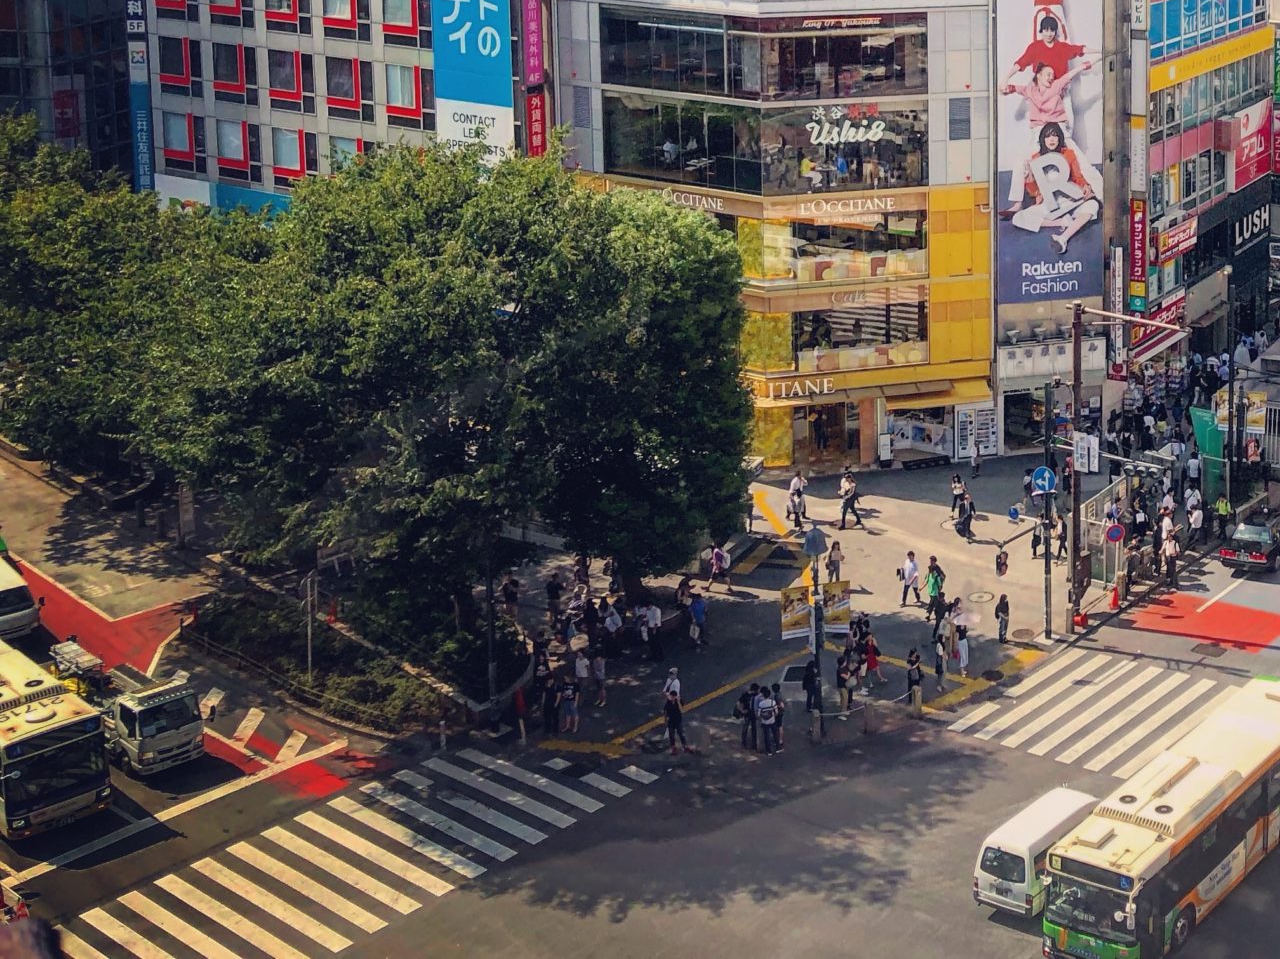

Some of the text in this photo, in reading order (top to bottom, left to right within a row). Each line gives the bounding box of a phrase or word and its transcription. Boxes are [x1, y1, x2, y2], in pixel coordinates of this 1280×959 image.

[129, 21, 143, 30] 5F
[528, 72, 541, 83] 4F
[452, 111, 496, 128] CONTACT
[530, 96, 542, 147] 外貨両替
[463, 127, 487, 140] LES
[806, 119, 886, 145] Ushi8
[1242, 134, 1265, 163] アコム
[660, 188, 725, 211] OCCITANE
[1235, 204, 1270, 246] LUSH
[1021, 259, 1083, 277] Rakuten
[1021, 279, 1079, 295] Fashion
